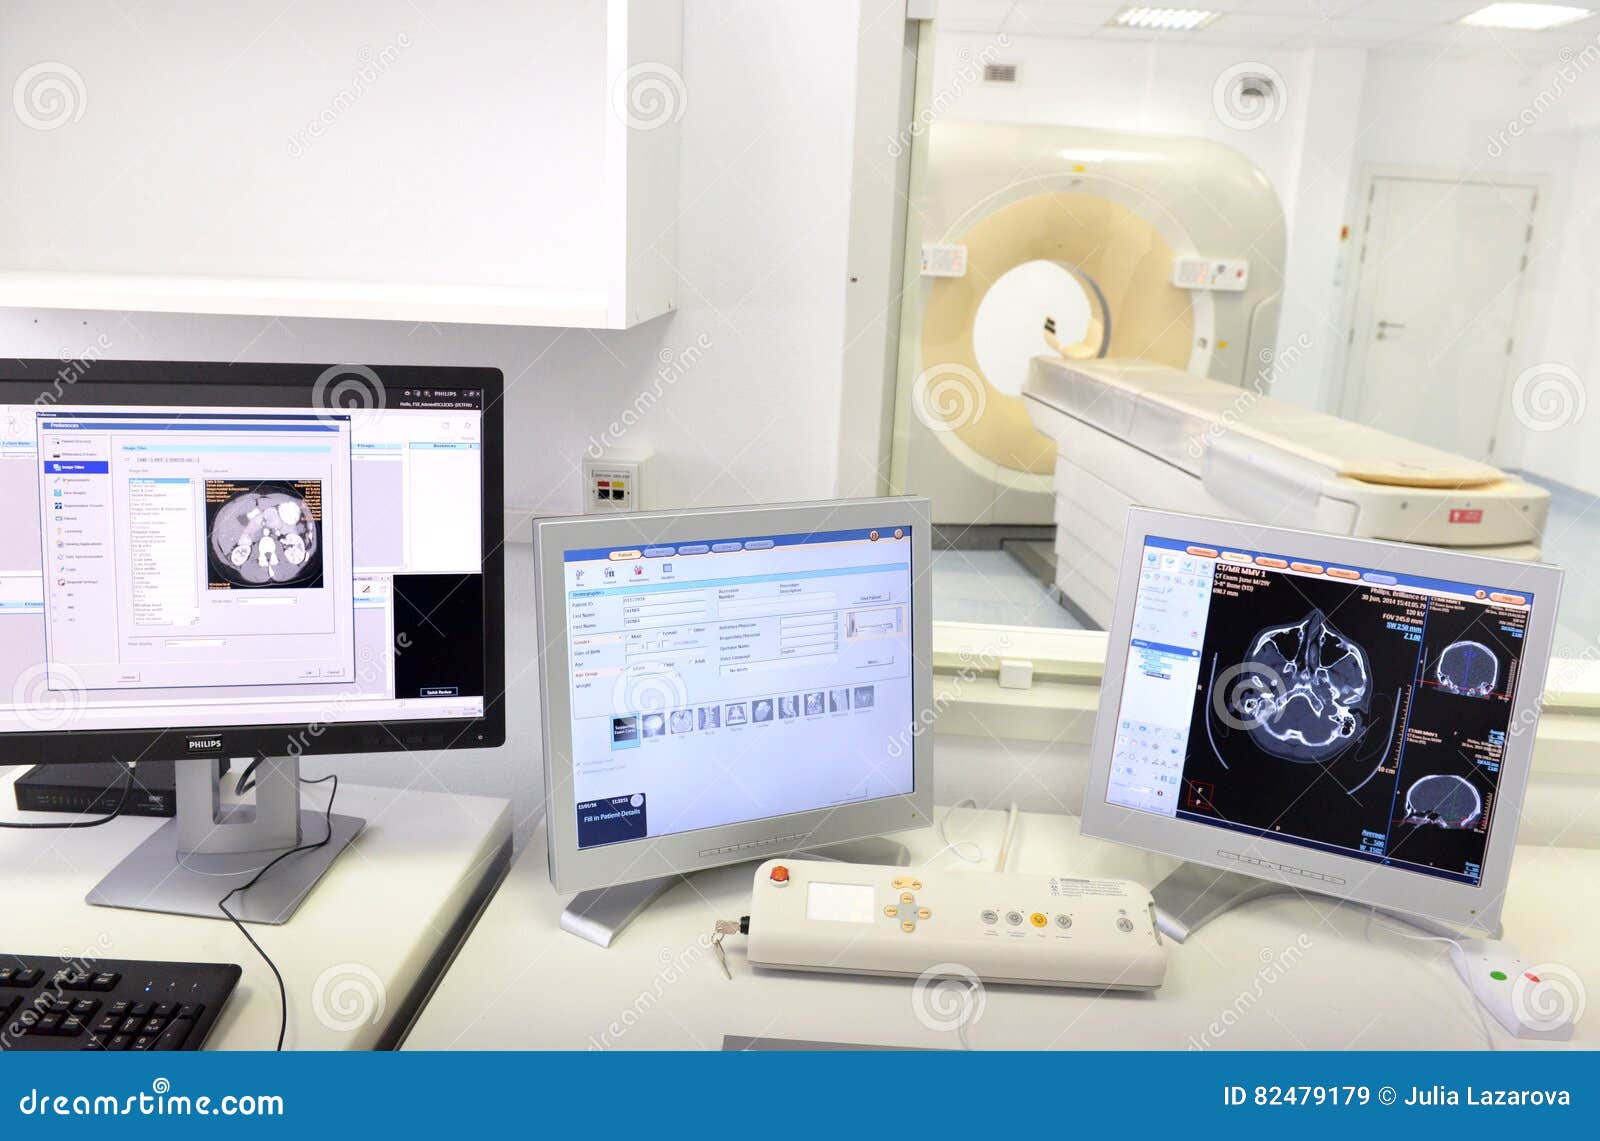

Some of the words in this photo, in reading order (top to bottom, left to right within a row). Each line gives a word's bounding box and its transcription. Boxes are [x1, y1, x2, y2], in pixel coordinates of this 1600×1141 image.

[188, 739, 222, 750] PHILIPS
[583, 815, 593, 823] Fill
[600, 811, 621, 820] Patient
[621, 808, 641, 817] Details
